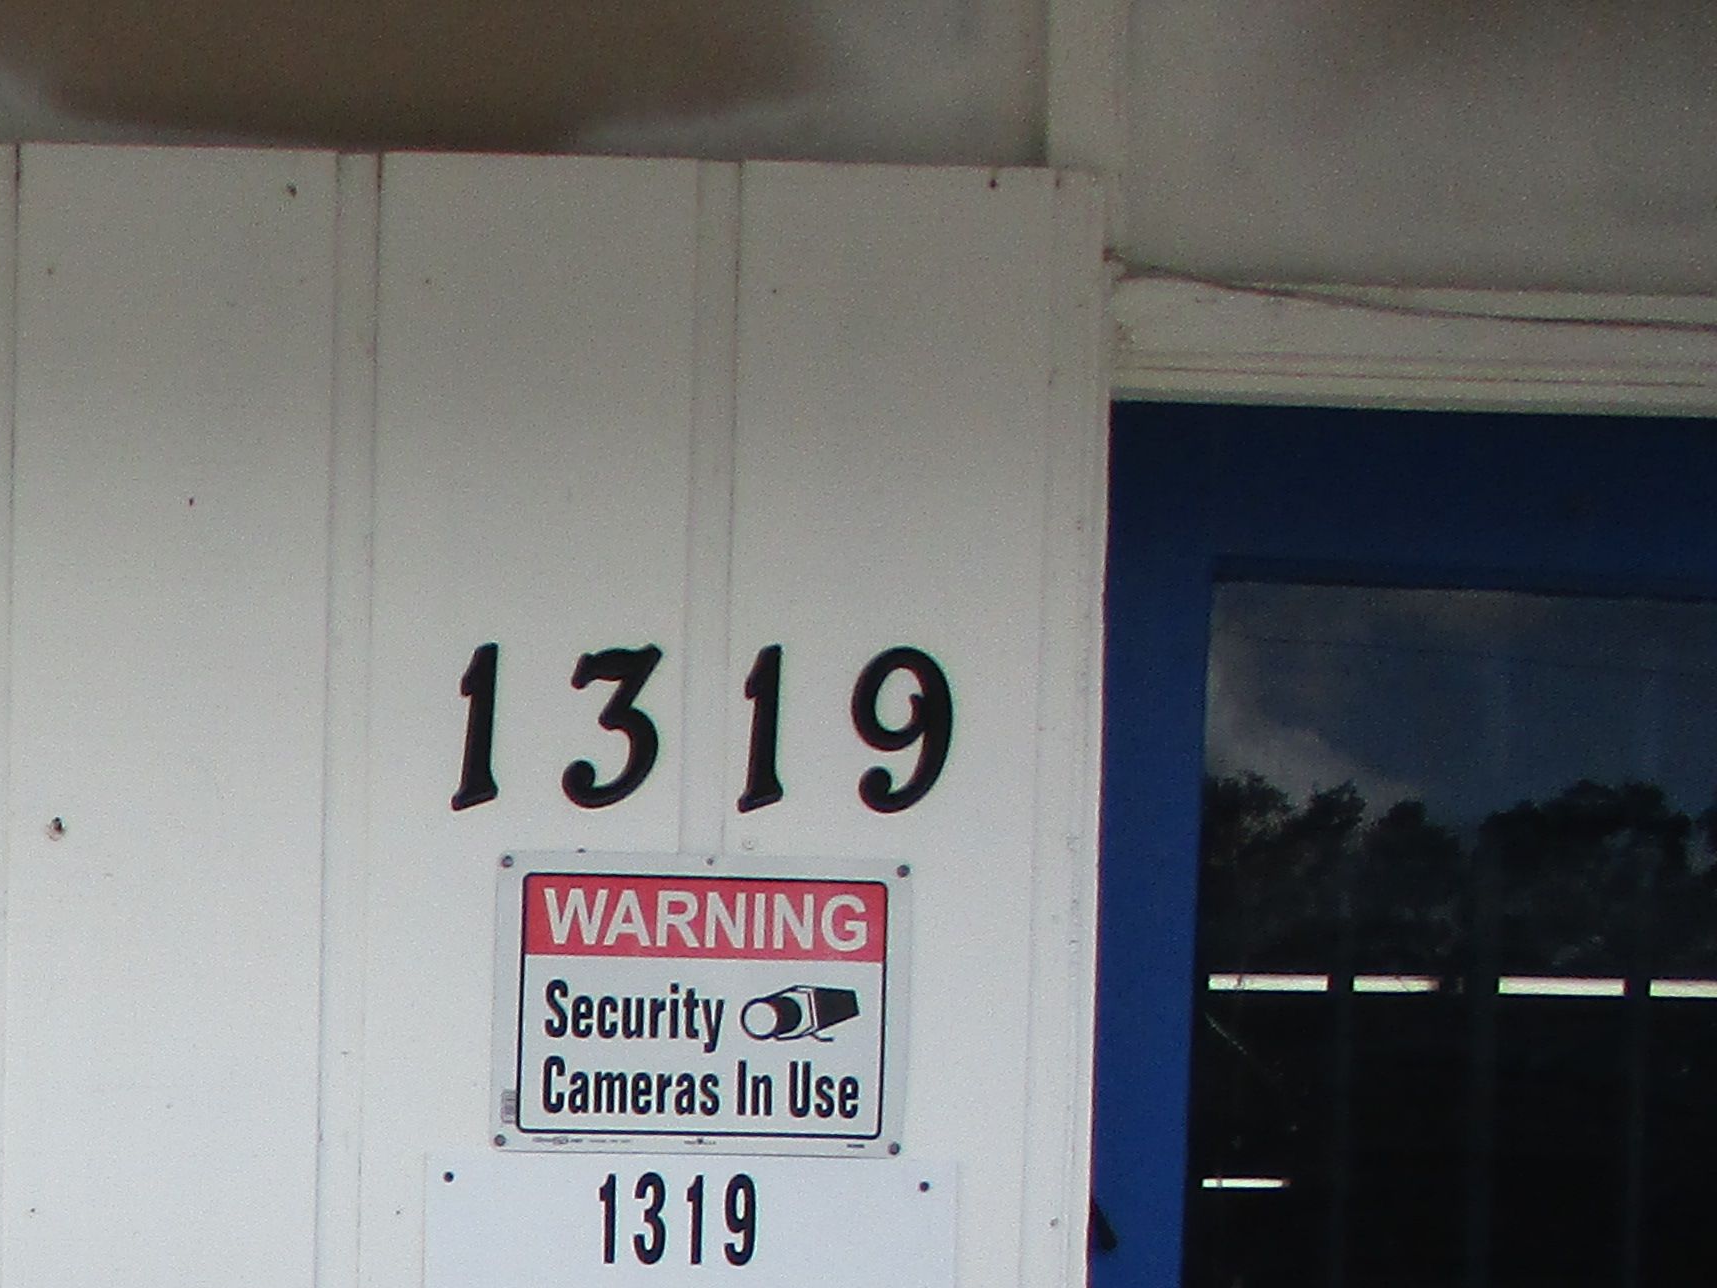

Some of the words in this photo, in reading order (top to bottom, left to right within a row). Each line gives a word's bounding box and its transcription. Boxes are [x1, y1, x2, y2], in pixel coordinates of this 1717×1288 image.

[452, 643, 953, 813] 1319
[545, 889, 866, 951] WARNING
[546, 980, 723, 1053] Security
[543, 1056, 719, 1115] Cameras
[738, 1061, 772, 1116] In
[790, 1062, 858, 1118] Use
[600, 1173, 755, 1266] 1319
